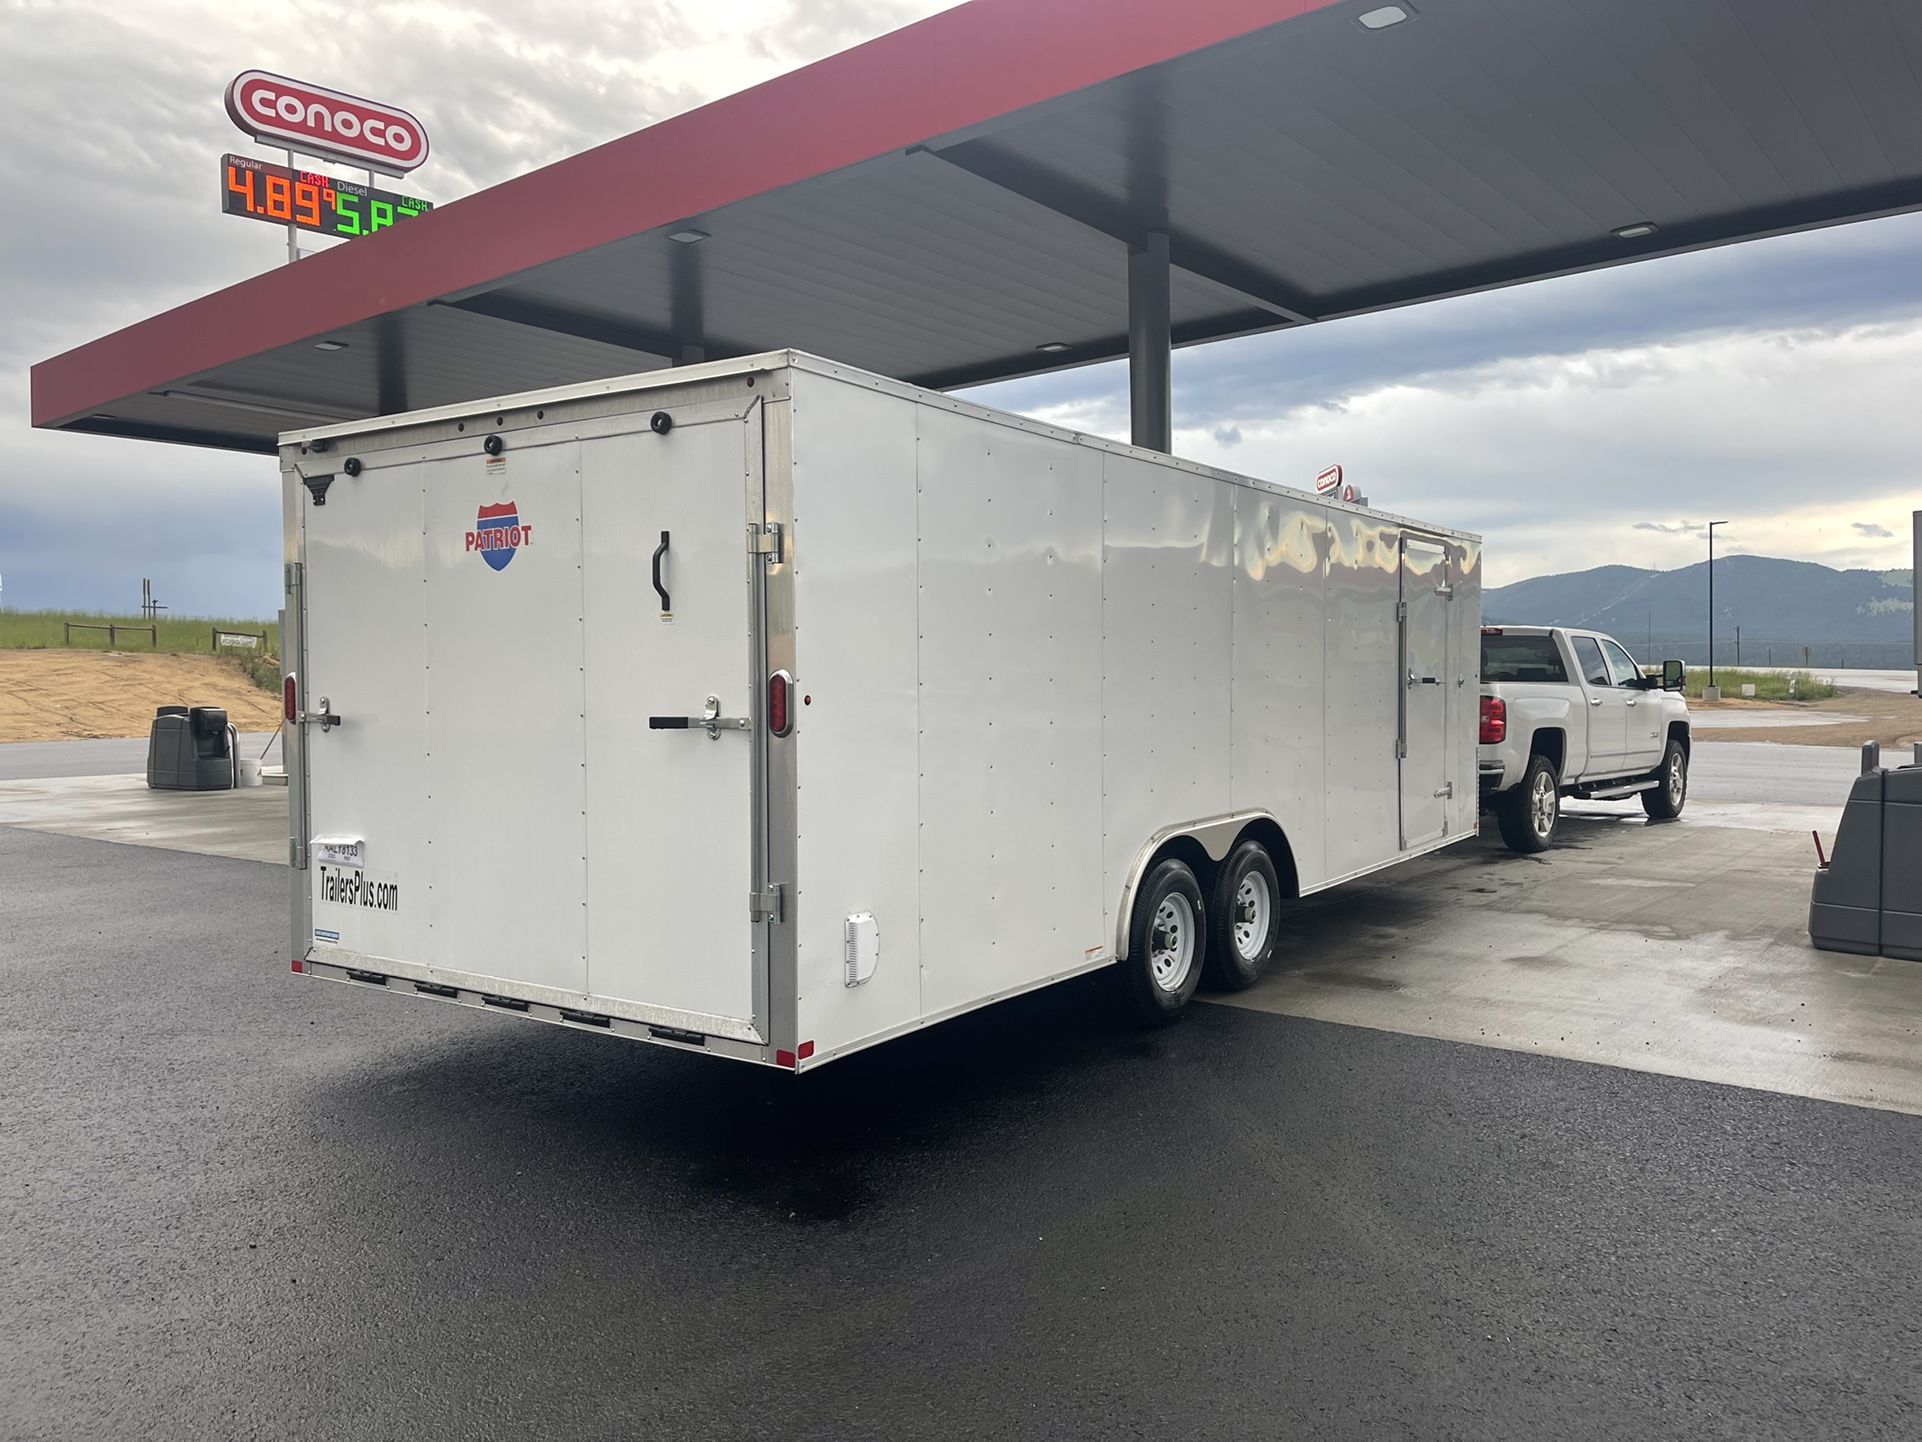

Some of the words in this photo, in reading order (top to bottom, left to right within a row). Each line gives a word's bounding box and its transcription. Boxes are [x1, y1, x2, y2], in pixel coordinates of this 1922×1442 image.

[229, 156, 262, 171] Regular
[300, 171, 329, 187] CASH
[337, 181, 367, 197] Diesel
[401, 196, 428, 211] CASH
[465, 525, 532, 552] PATRIOT
[320, 866, 398, 911] TrailersPlus.com
